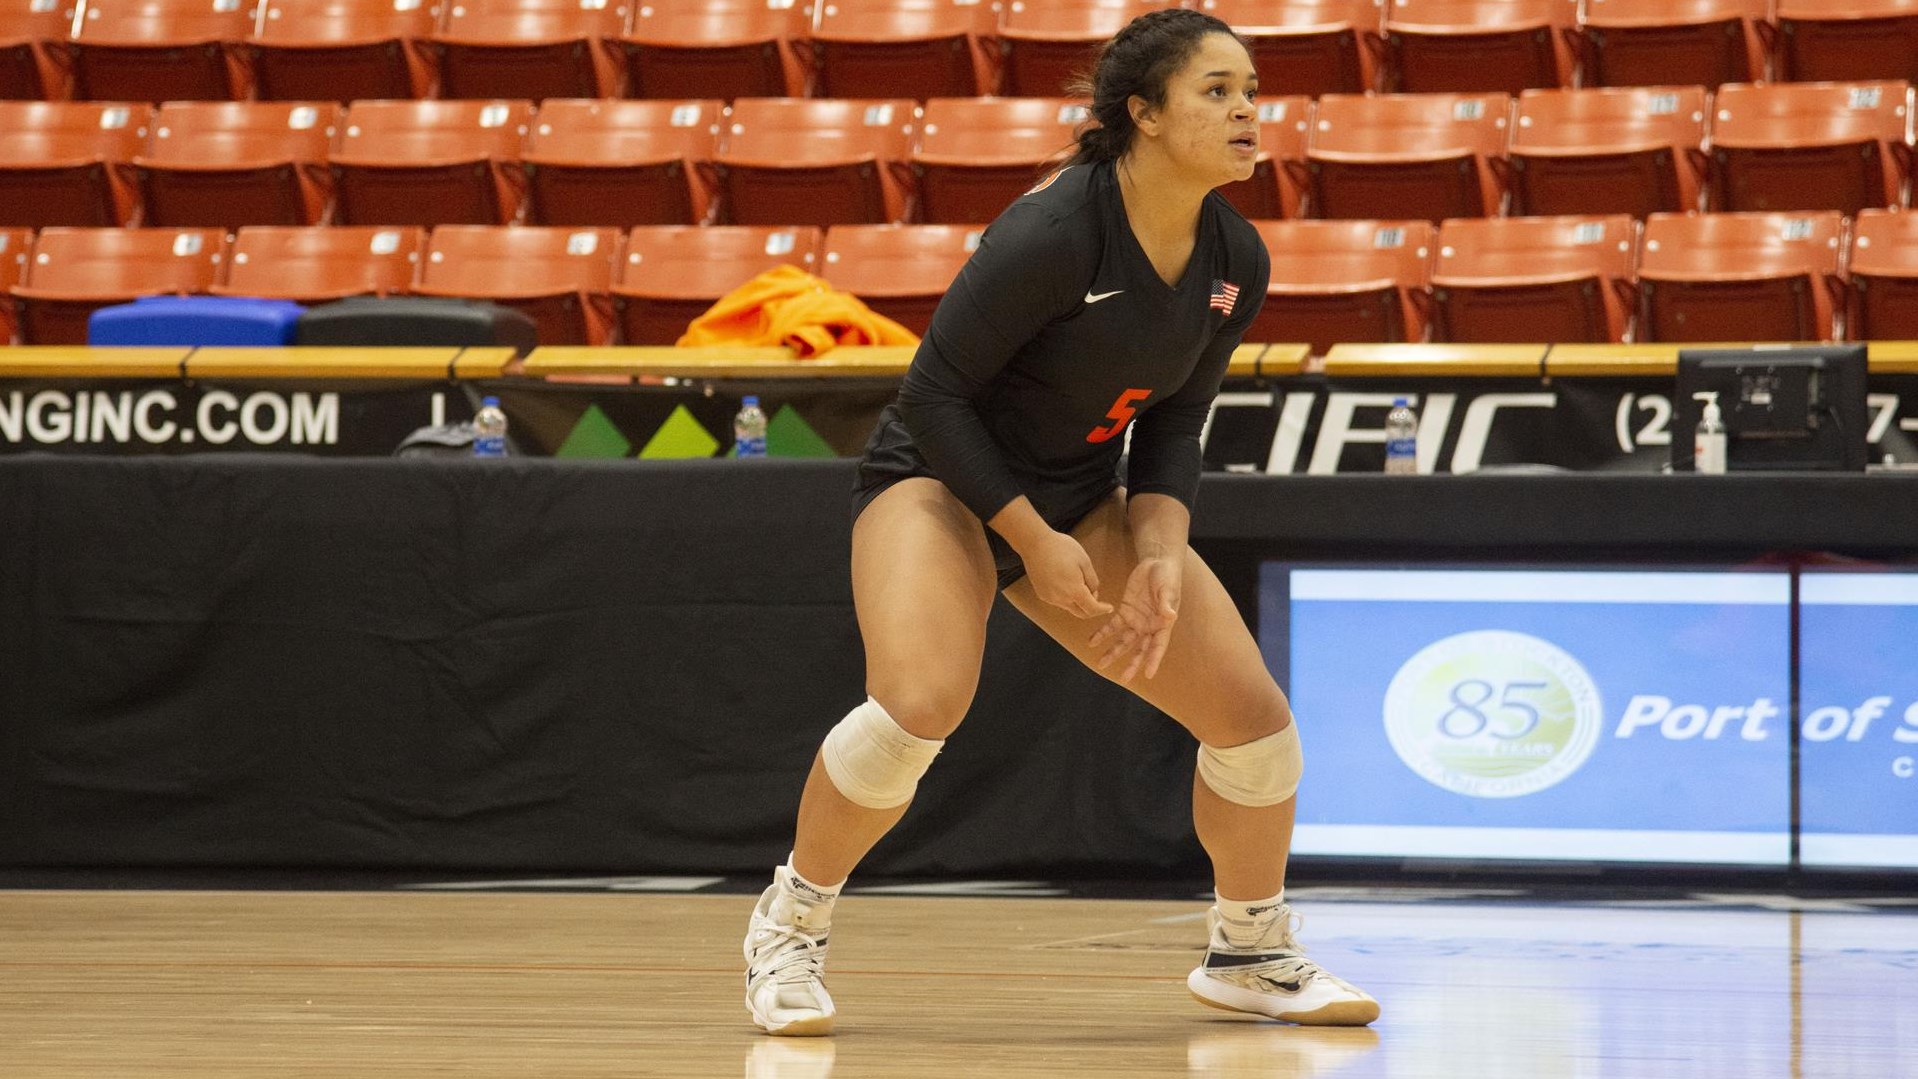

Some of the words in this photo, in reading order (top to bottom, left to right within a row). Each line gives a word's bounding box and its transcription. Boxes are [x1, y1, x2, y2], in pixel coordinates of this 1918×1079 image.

[1086, 388, 1152, 444] 5
[1437, 679, 1548, 740] 85
[1614, 695, 1779, 741] Port
[1802, 696, 1893, 742] of
